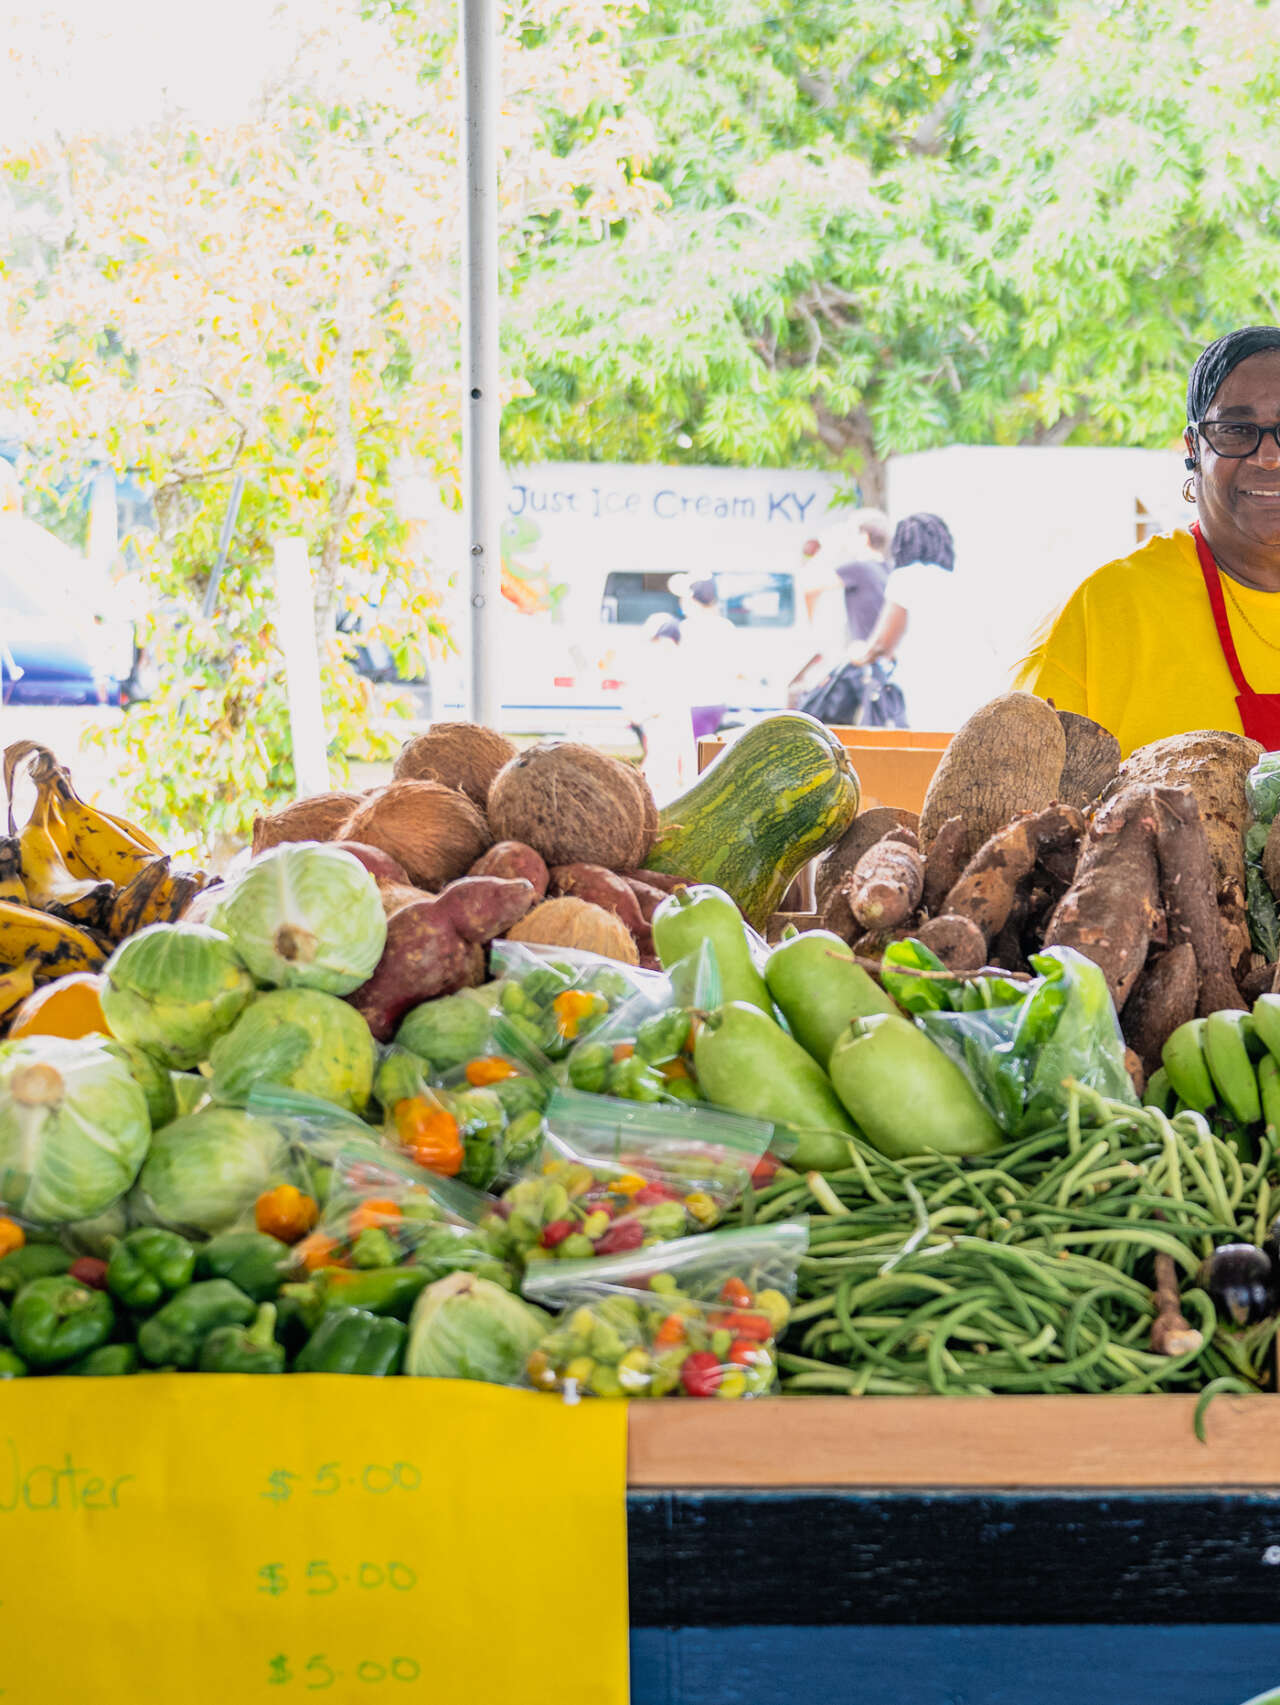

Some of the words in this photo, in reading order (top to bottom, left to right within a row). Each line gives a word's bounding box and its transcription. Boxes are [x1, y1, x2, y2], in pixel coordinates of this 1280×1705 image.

[506, 484, 578, 516] Just
[592, 488, 642, 518] Ice
[652, 489, 757, 519] Cream
[767, 491, 817, 523] KY
